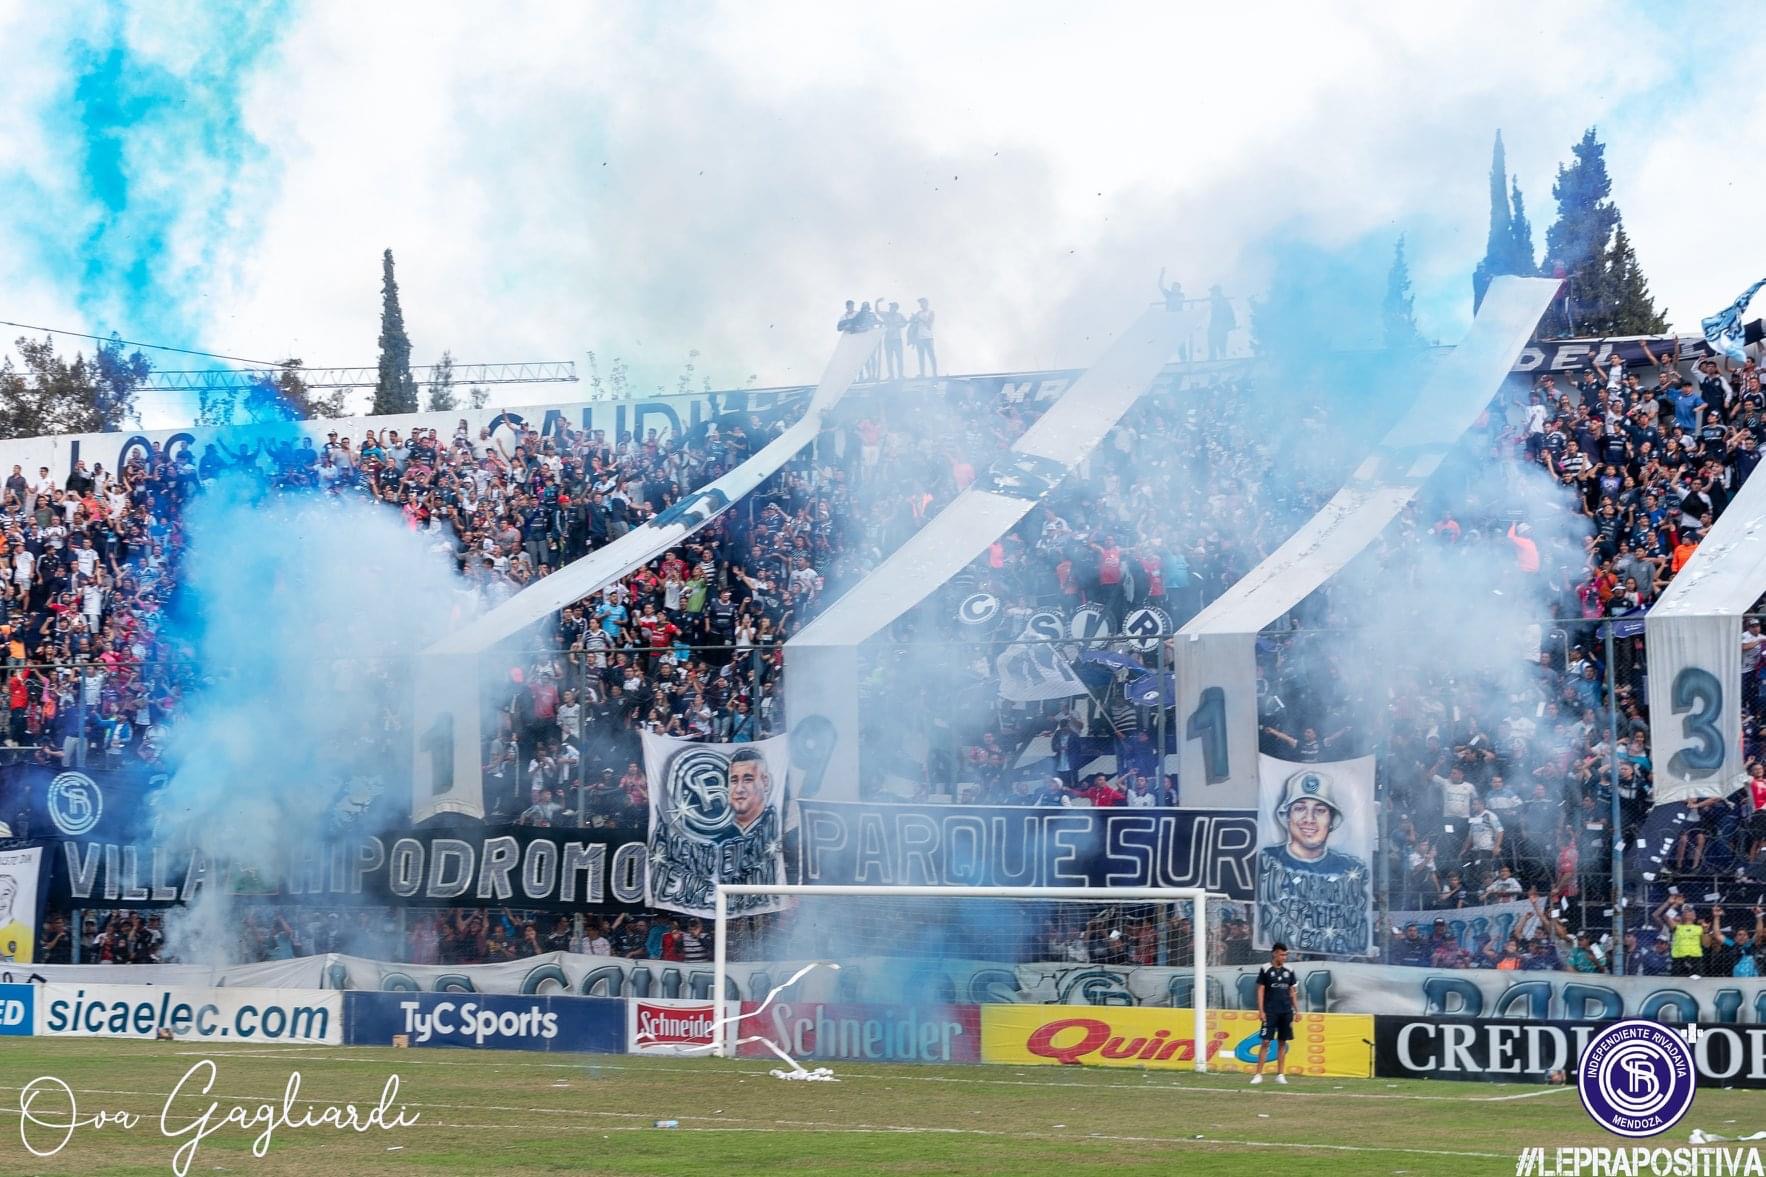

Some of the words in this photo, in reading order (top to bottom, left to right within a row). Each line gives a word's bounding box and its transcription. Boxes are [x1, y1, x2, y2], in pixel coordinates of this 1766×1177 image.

[1128, 610, 1160, 647] R
[1186, 686, 1229, 786] 1
[1667, 667, 1725, 782] 3
[63, 841, 216, 900] VILLA
[804, 809, 1091, 889] PARQUE
[1105, 816, 1258, 891] SUR
[47, 990, 329, 1039] sicaelec.com
[400, 1001, 455, 1042] TyC
[460, 1003, 559, 1045] Sports
[640, 1010, 719, 1039] Schneide
[771, 1003, 963, 1061] Schneider
[1026, 1017, 1230, 1065] Quini
